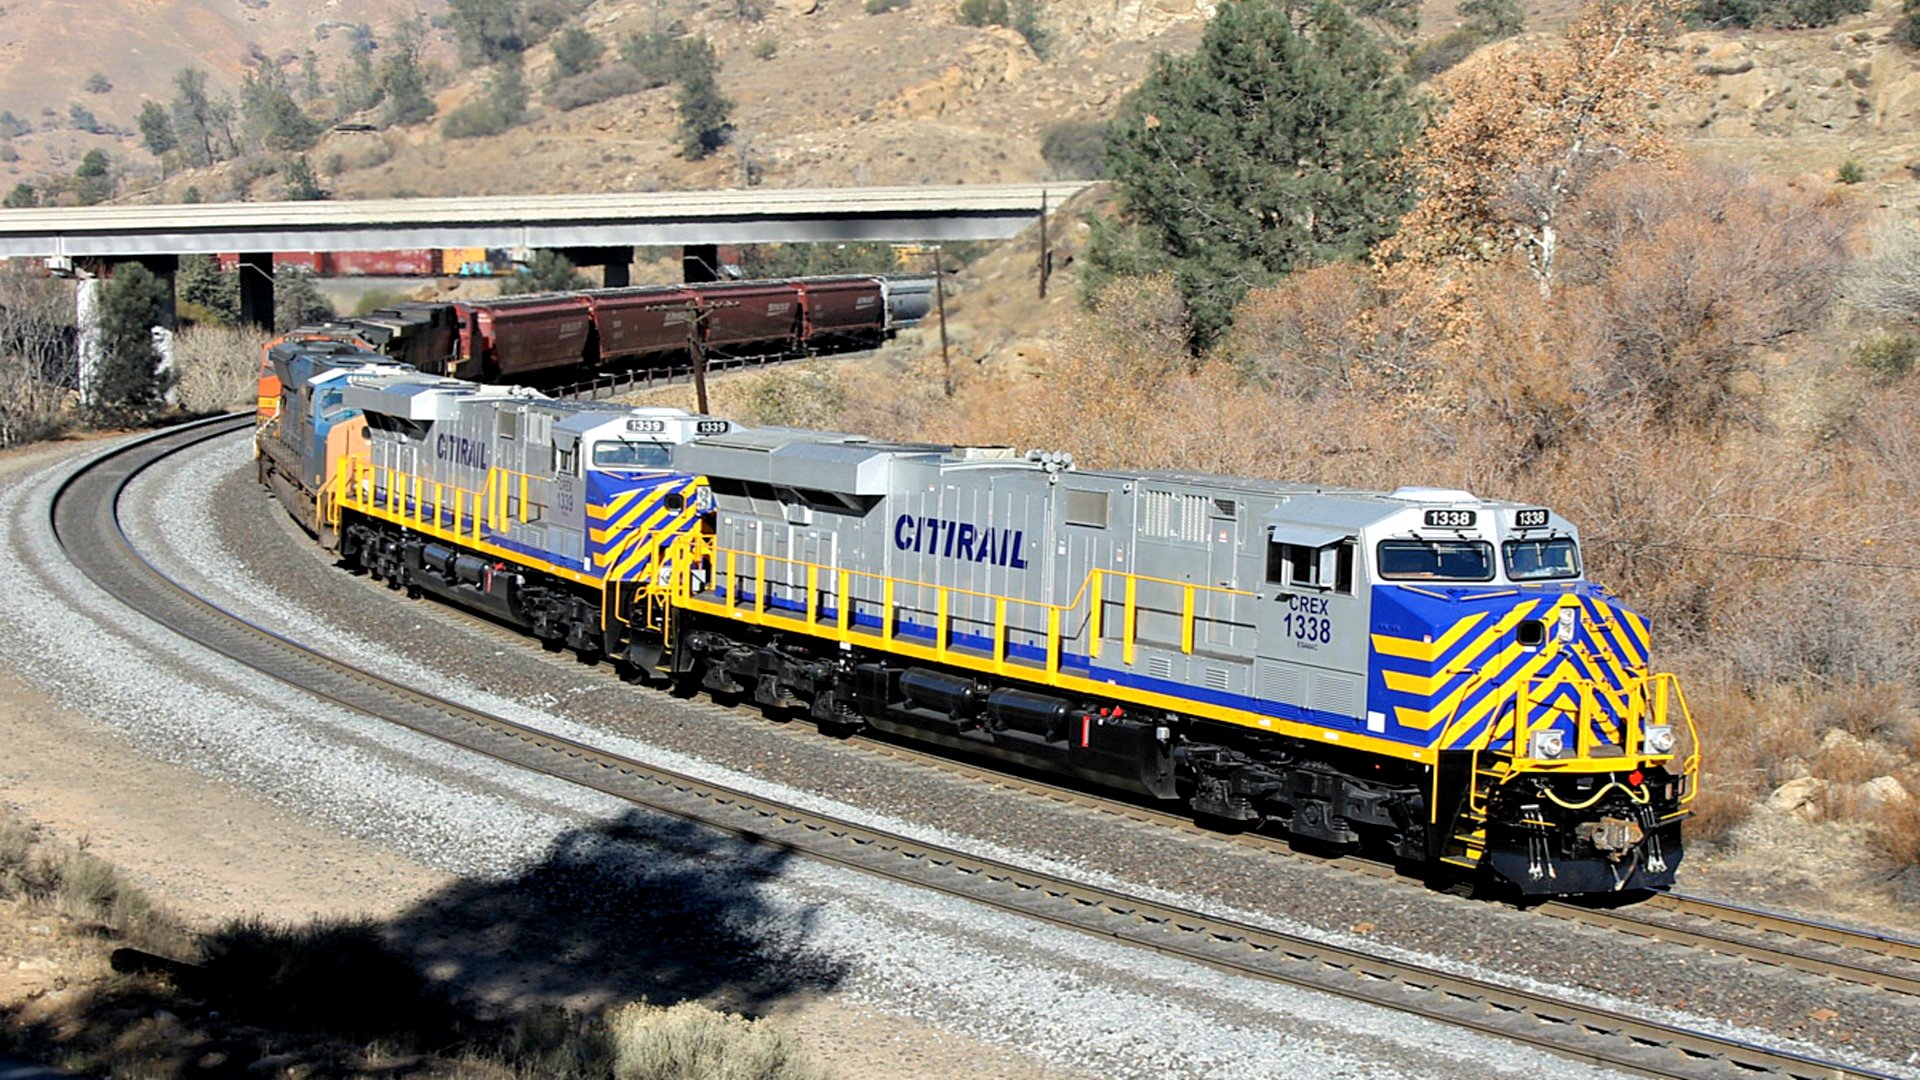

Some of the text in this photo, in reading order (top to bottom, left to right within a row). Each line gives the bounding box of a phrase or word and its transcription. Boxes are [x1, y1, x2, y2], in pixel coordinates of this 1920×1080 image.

[631, 421, 661, 430] 1339
[700, 422, 726, 432] 1339
[1430, 511, 1470, 525] 1338
[1520, 511, 1545, 524] 1338
[894, 513, 1029, 570] CITIRAIL
[1289, 593, 1329, 616] CREX
[1283, 613, 1331, 644] 1338
